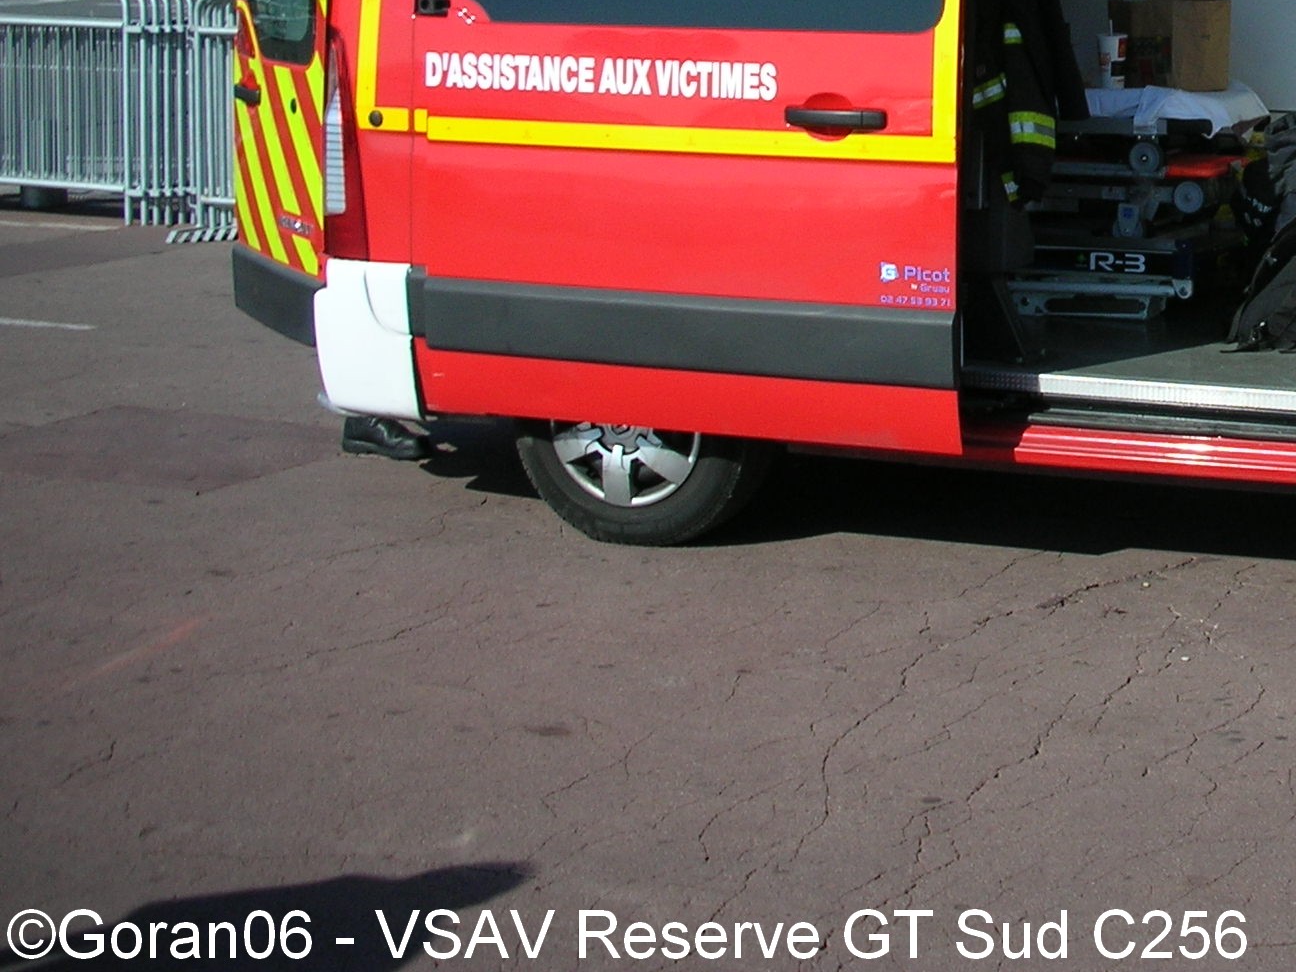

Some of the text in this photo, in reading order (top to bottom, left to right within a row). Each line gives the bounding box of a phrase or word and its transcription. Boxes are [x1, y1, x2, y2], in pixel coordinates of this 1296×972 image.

[424, 51, 777, 101] D'ASSISTANCE AUX VICTIMES
[1089, 251, 1146, 273] R-3
